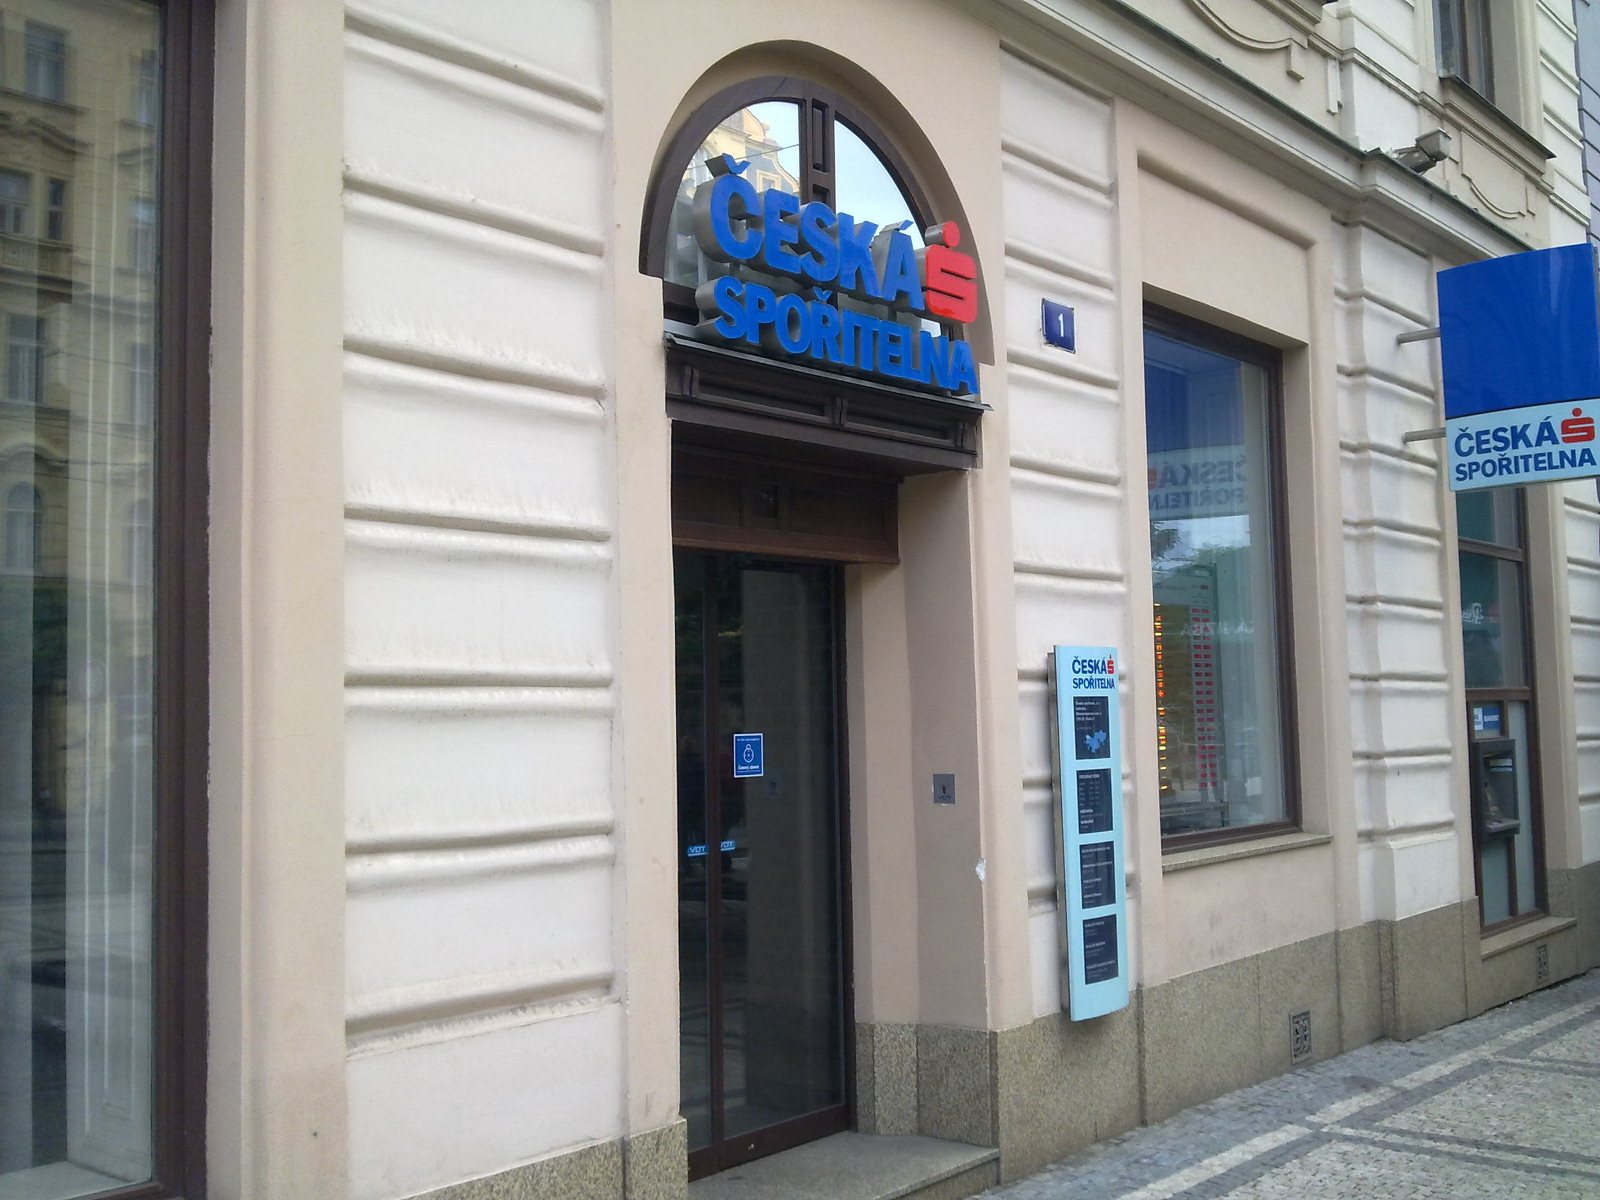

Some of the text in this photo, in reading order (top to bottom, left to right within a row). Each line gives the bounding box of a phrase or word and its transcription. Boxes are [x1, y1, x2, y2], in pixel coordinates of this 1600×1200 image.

[708, 153, 925, 311] ČESKÁ
[712, 275, 980, 396] SPOŘITELNA
[1058, 313, 1065, 338] 1
[1454, 415, 1560, 458] ČESKÁ
[1455, 447, 1598, 483] SPOŘITELNA
[1071, 655, 1108, 675] ČESKÁ
[1072, 676, 1116, 690] SPOŘITELNA
